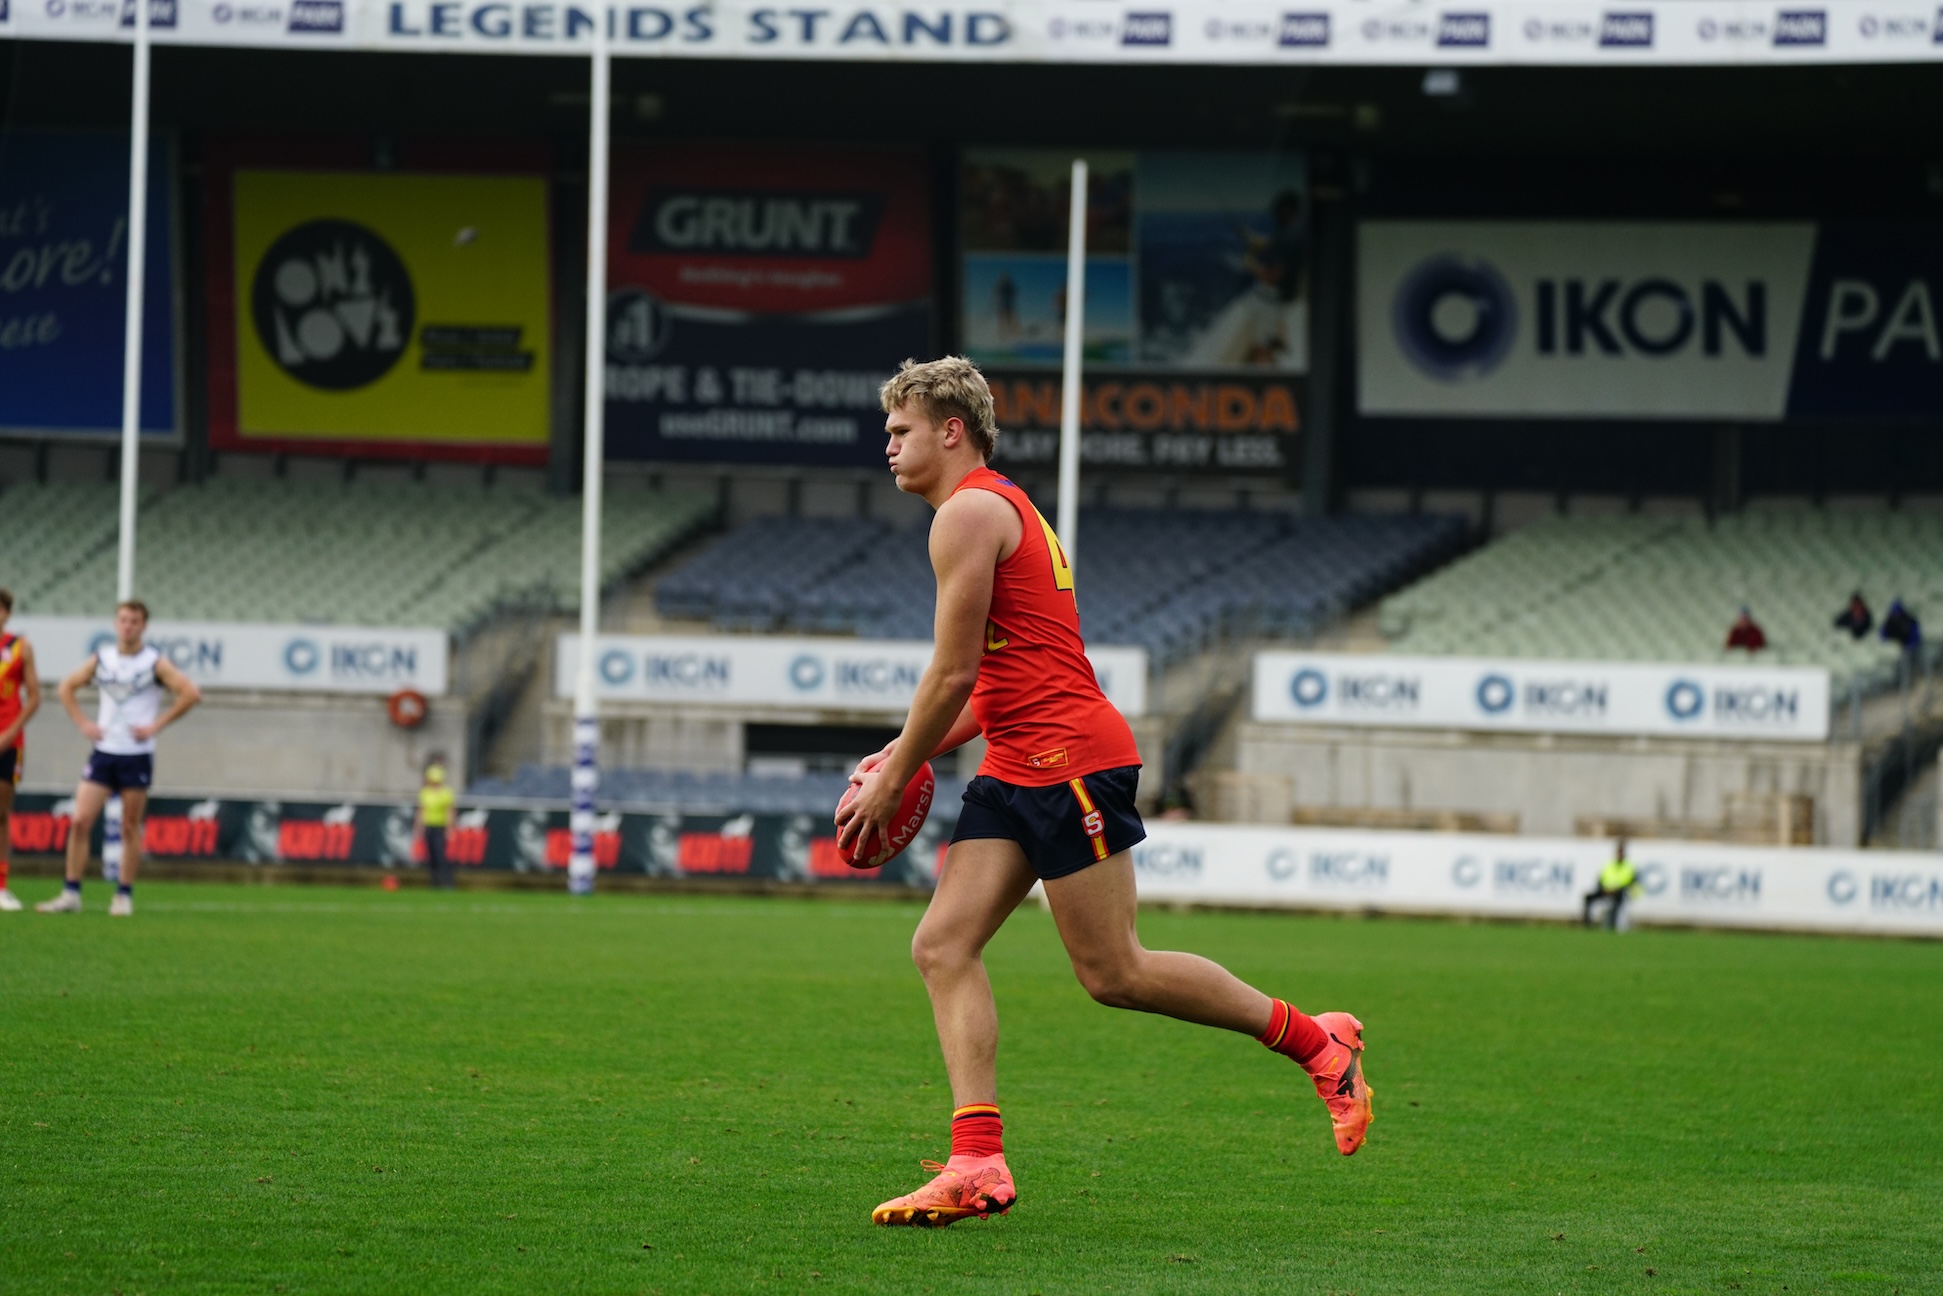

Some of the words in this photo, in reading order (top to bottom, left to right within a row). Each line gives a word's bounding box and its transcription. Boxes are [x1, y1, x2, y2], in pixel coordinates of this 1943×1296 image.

[388, 2, 713, 40] LEGENDS
[747, 9, 1011, 46] STAND
[655, 196, 861, 250] GRUNT
[1536, 280, 1766, 357] IKON
[892, 779, 935, 845] Marsh
